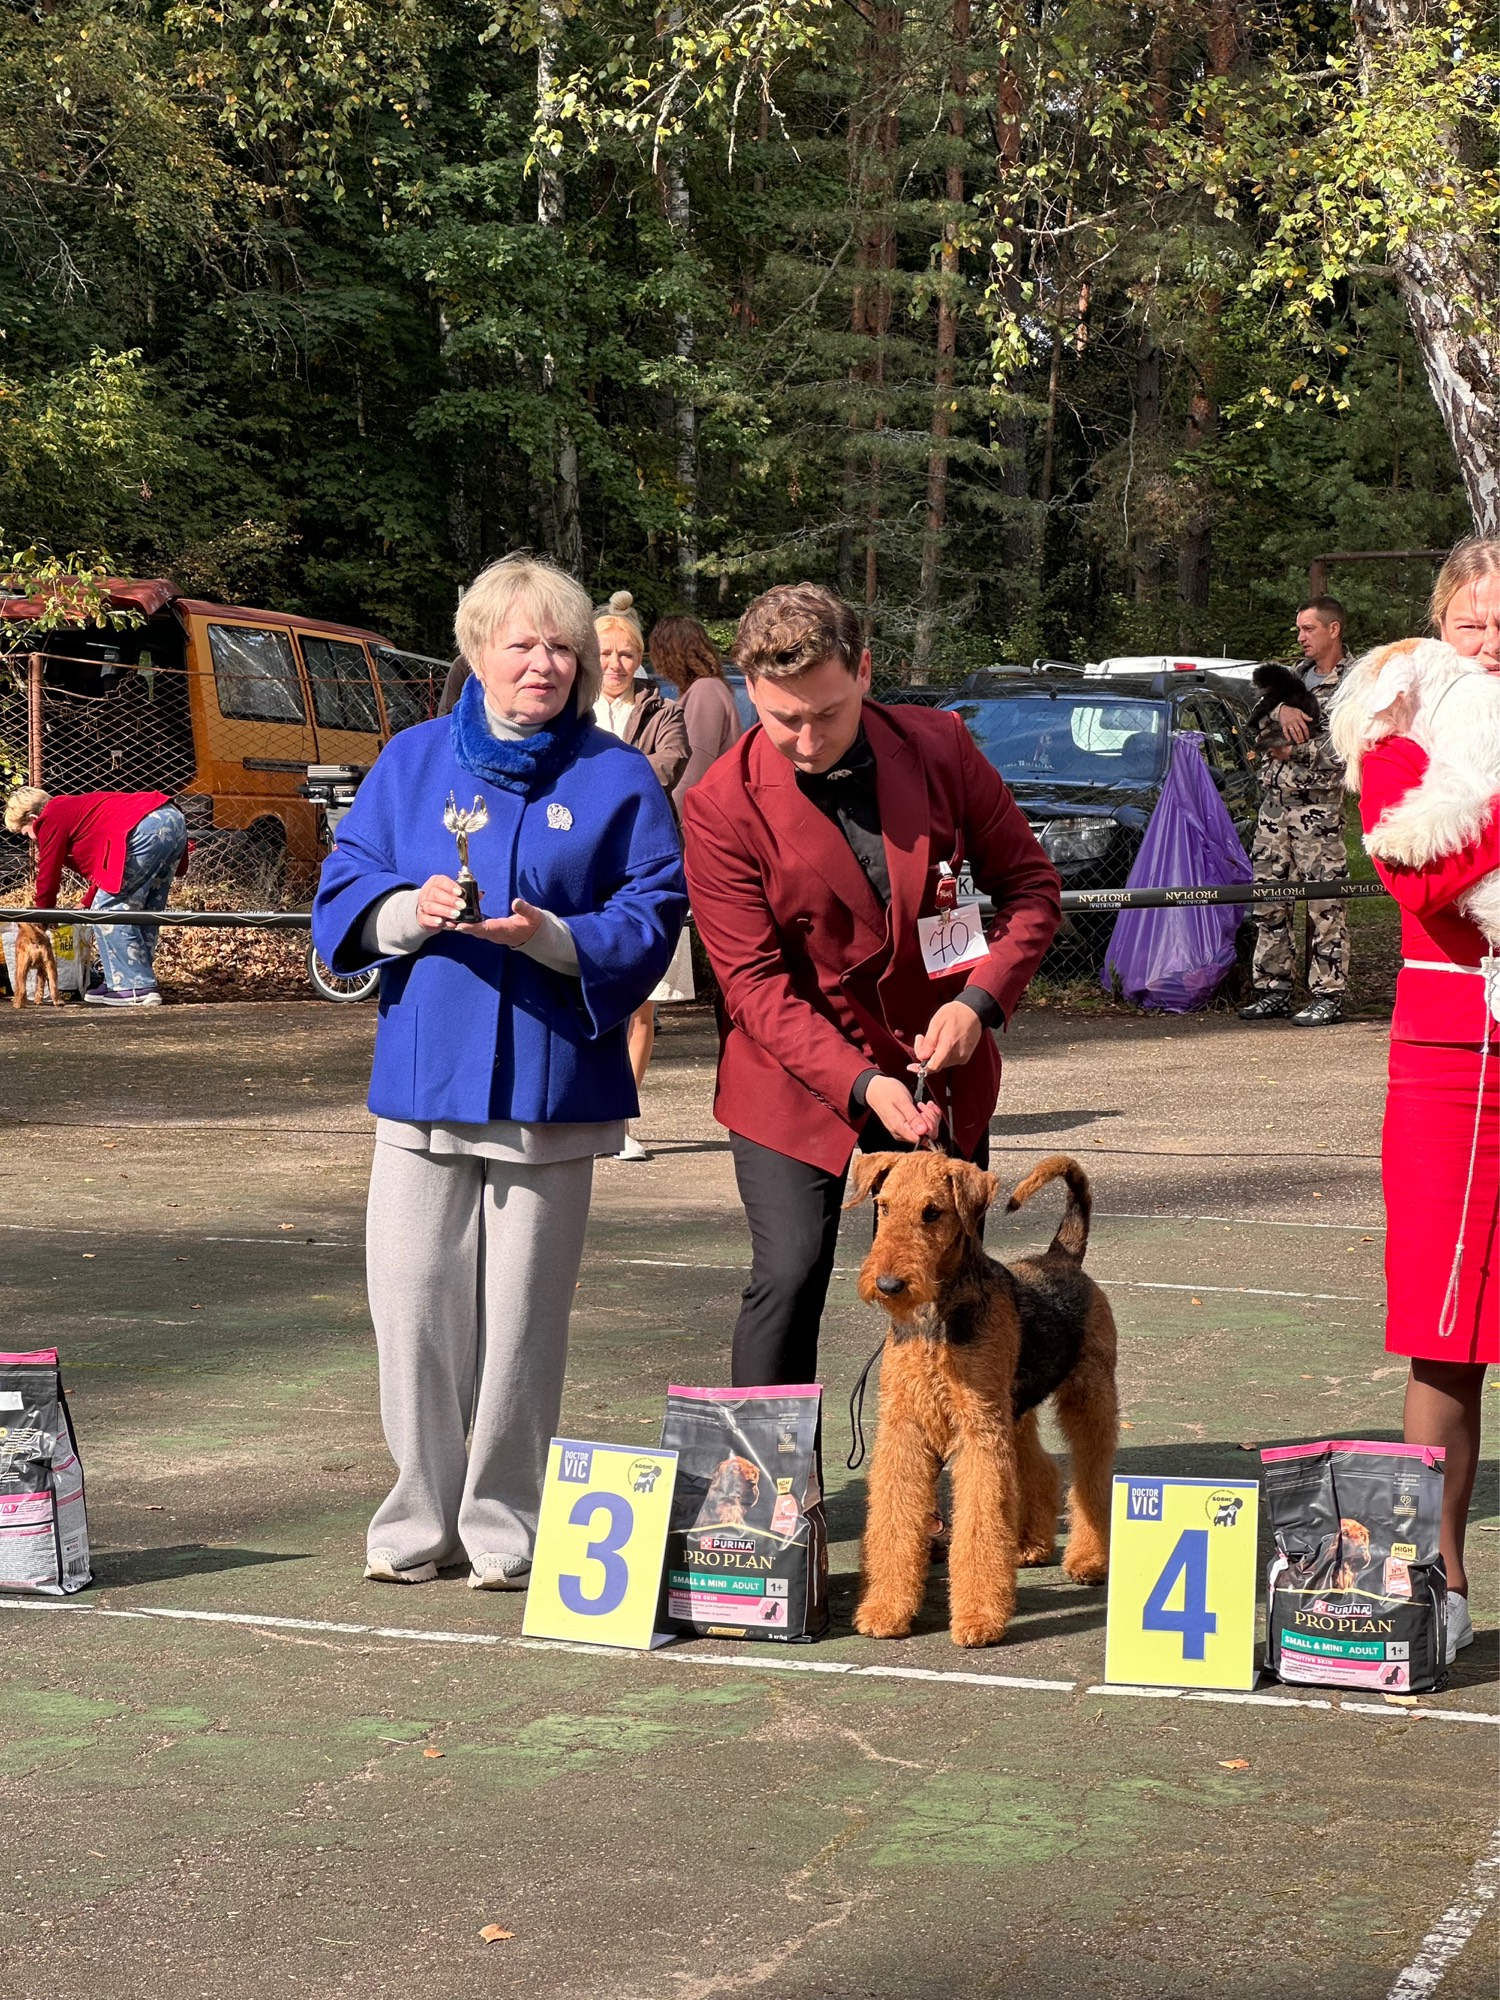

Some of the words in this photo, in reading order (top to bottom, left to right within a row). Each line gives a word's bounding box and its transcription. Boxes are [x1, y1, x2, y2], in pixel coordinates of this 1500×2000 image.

[1196, 890, 1218, 899] PRO
[1252, 888, 1281, 897] PLAN
[1283, 887, 1305, 896] PRO
[1341, 885, 1369, 894] PLAN
[1078, 893, 1107, 903] PLAN
[1108, 892, 1131, 902] PRO
[1165, 891, 1194, 900] PLAN
[929, 921, 969, 963] 70
[564, 1450, 589, 1461] DOCTOR
[564, 1458, 588, 1479] VIC
[1131, 1487, 1159, 1498] DOCTOR
[1131, 1496, 1159, 1516] VIC
[713, 1539, 753, 1550] PURINA
[1394, 1546, 1413, 1554] HIGH
[558, 1491, 634, 1616] 3
[682, 1550, 720, 1566] PRO
[722, 1553, 773, 1570] PLAN
[672, 1575, 699, 1587] SMALL
[699, 1579, 706, 1587] &
[707, 1579, 727, 1588] MINI
[732, 1581, 760, 1590] ADULT
[770, 1583, 783, 1592] 1+
[672, 1591, 702, 1601] SENSITIVE
[703, 1594, 718, 1602] SKIN
[1142, 1529, 1217, 1660] 4
[1327, 1605, 1370, 1616] PURINA
[1294, 1611, 1334, 1631] PRO
[1337, 1619, 1393, 1633] PLAN
[1284, 1636, 1312, 1649] SMALL
[1313, 1642, 1320, 1650] &
[1322, 1643, 1343, 1653] MINI
[1348, 1645, 1379, 1655] ADULT
[1390, 1646, 1404, 1656] 1+
[1285, 1652, 1316, 1664] SENSITIVE
[1317, 1658, 1333, 1666] SKIN
